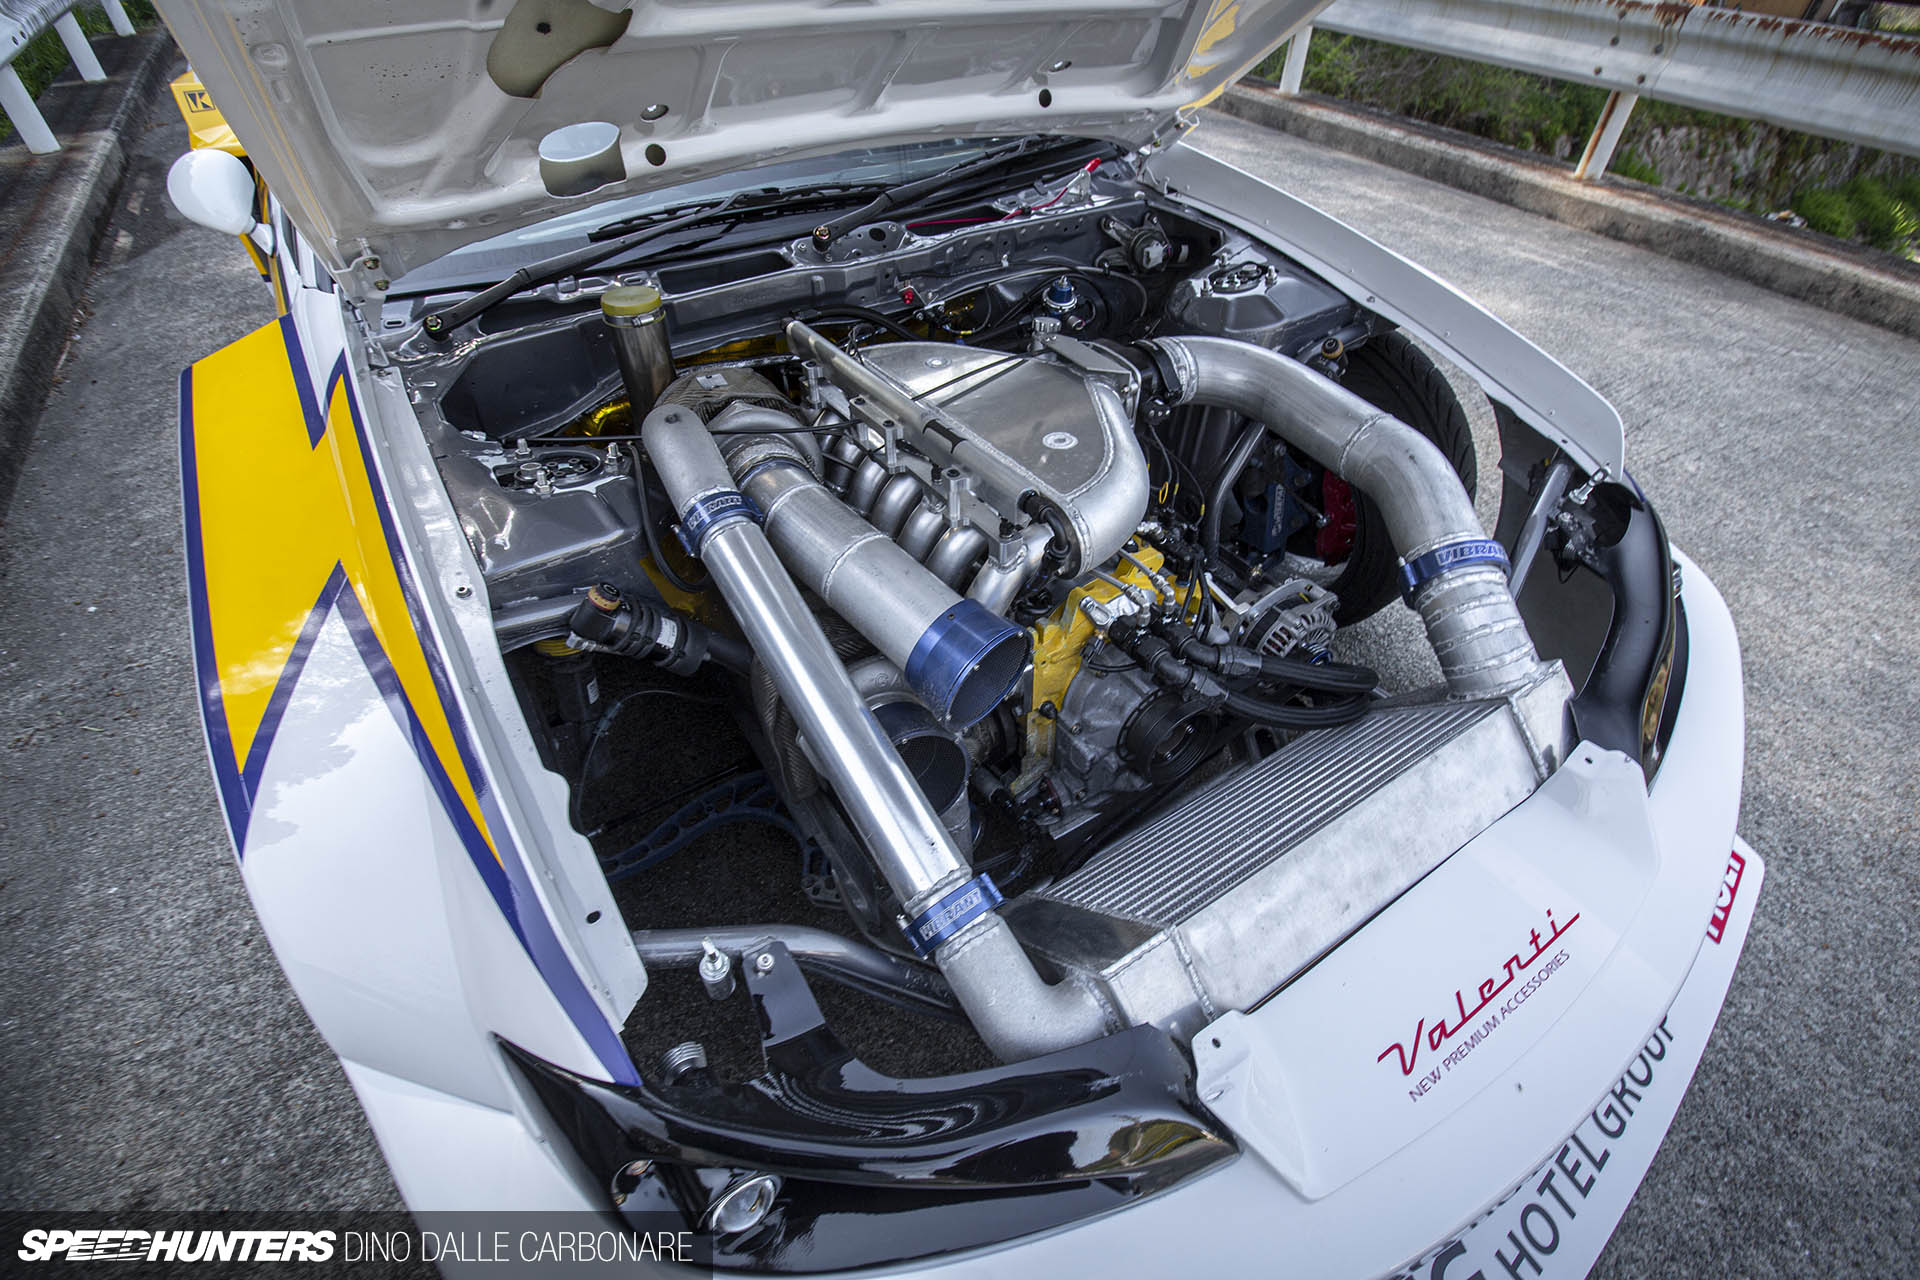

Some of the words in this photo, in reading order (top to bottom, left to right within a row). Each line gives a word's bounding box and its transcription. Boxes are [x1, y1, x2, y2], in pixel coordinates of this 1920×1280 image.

[919, 887, 983, 941] VIBRANT
[1377, 908, 1580, 1076] Valenti
[1409, 1066, 1441, 1102] NEW
[1442, 1014, 1501, 1072] PREMIUM
[1500, 948, 1570, 1021] ACCESSORIES
[1495, 1133, 1611, 1280] HOTEL
